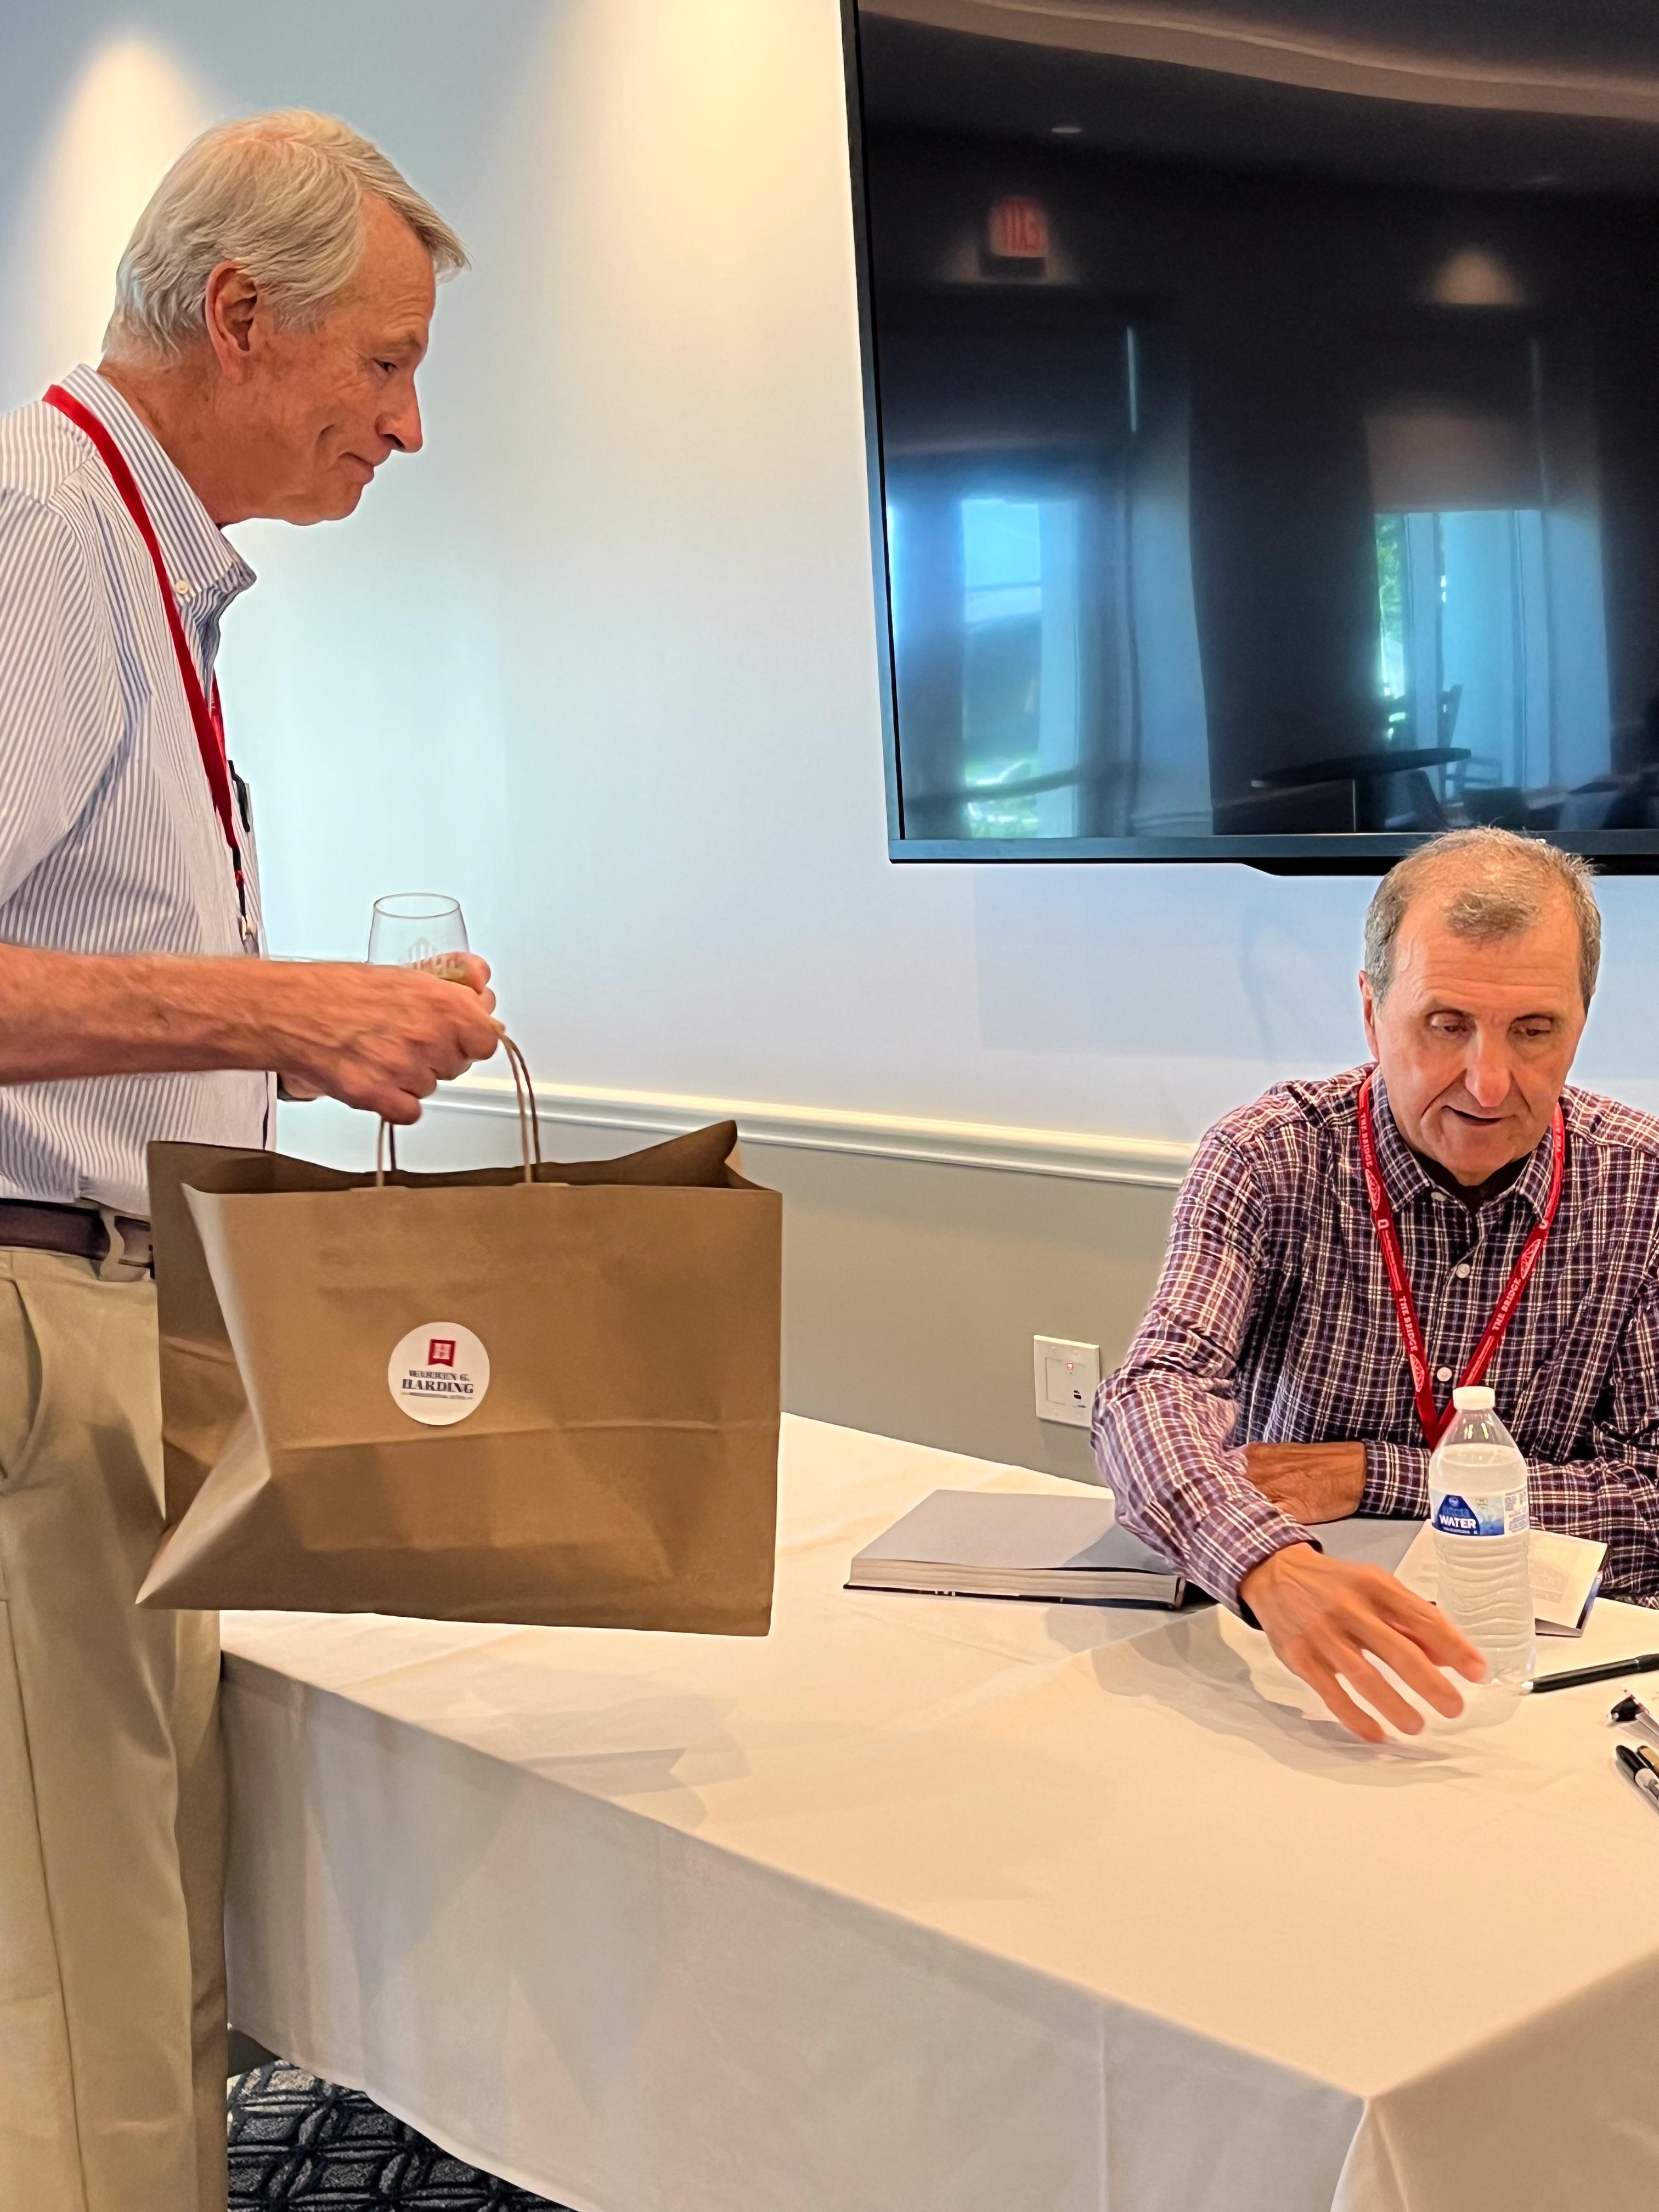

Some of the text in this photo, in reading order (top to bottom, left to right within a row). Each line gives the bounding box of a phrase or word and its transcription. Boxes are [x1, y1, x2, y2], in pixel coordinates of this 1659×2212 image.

[1492, 1278, 1521, 1330] THE BRIDGE
[1399, 1295, 1418, 1351] THE BRIDGE
[402, 1379, 474, 1394] HARDING
[1438, 1514, 1477, 1529] WATER
